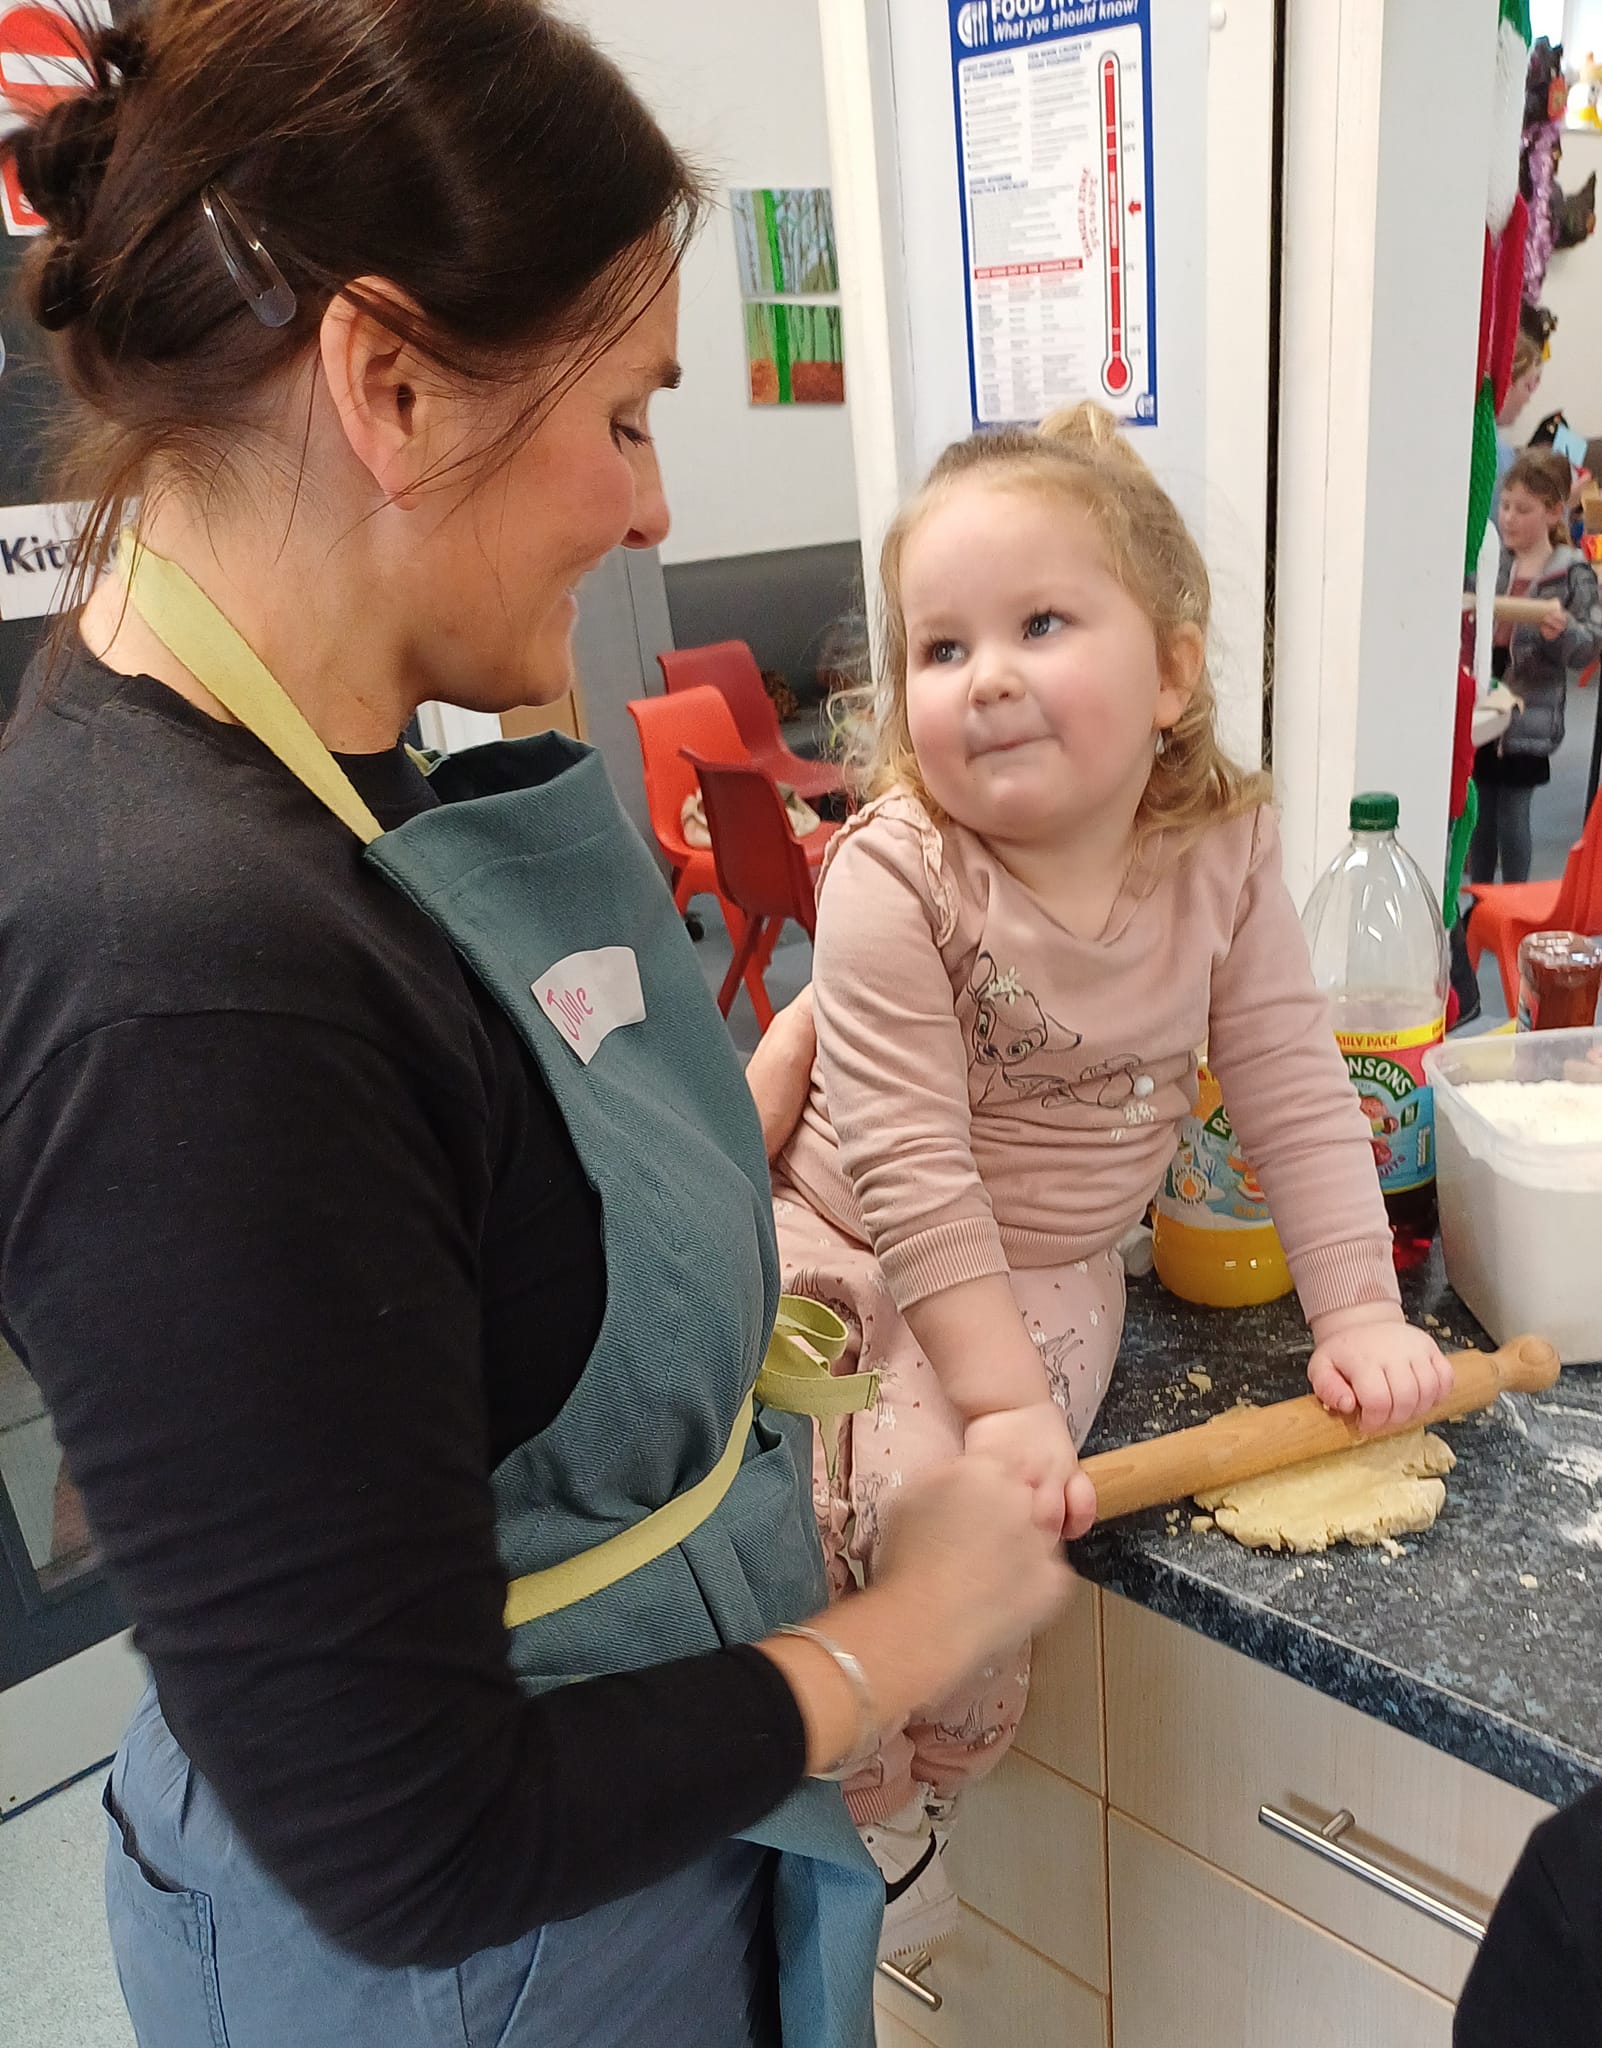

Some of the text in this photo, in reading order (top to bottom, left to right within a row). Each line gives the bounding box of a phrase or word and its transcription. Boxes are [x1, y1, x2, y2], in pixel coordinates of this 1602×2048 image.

[991, 0, 1045, 23] FOOD
[993, 19, 1024, 43] What
[1026, 16, 1049, 41] you
[1052, 2, 1096, 31] should
[1366, 1034, 1398, 1047] PACK
[1347, 1057, 1412, 1096] NSONS
